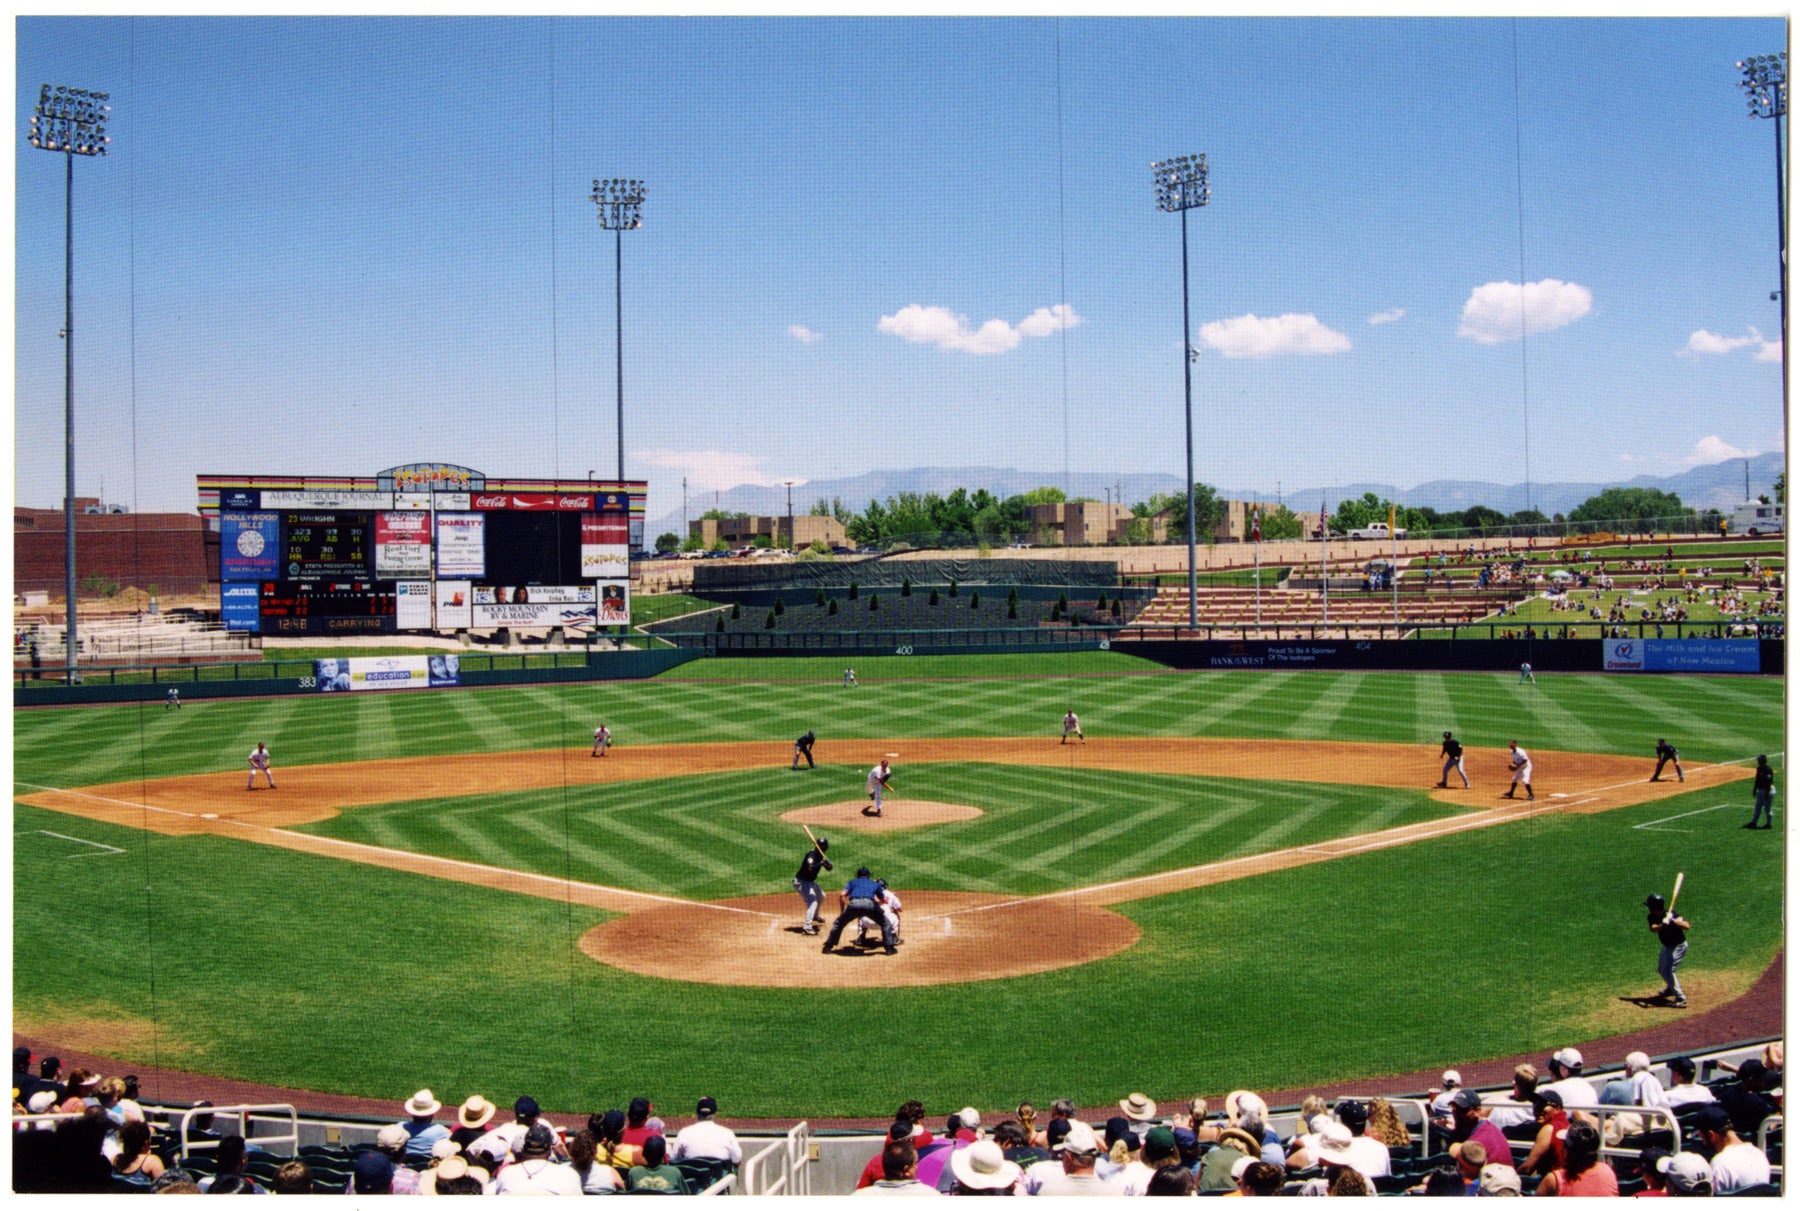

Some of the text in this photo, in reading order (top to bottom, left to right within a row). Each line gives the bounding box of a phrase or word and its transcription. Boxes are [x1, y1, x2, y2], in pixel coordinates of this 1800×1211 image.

[270, 491, 385, 501] ALBUQUERQUE JOURNAL
[476, 496, 507, 508] Coca-Cola
[560, 497, 590, 508] Coca-Cola
[223, 514, 278, 522] HOLLYWOOD
[288, 515, 298, 523] 23
[300, 515, 335, 523] VAUGHN
[238, 521, 263, 529] HILLS
[352, 535, 360, 543] H
[482, 605, 507, 613] ROCKY
[491, 612, 502, 620] RV
[511, 612, 539, 620] MARINE
[279, 618, 307, 630] 12:48
[328, 619, 381, 628] CARRYING
[896, 645, 913, 655] 400
[1355, 641, 1371, 650] 404
[1647, 644, 1756, 653] The Milk and Ice Cream
[1267, 647, 1286, 655] Proud
[1311, 648, 1337, 656] Sponsor
[1211, 656, 1234, 665] BANK
[1241, 656, 1265, 665] WEST
[1289, 654, 1316, 662] Isotopes
[1667, 657, 1735, 667] of New Mexico
[366, 671, 410, 681] education
[298, 676, 317, 688] 383
